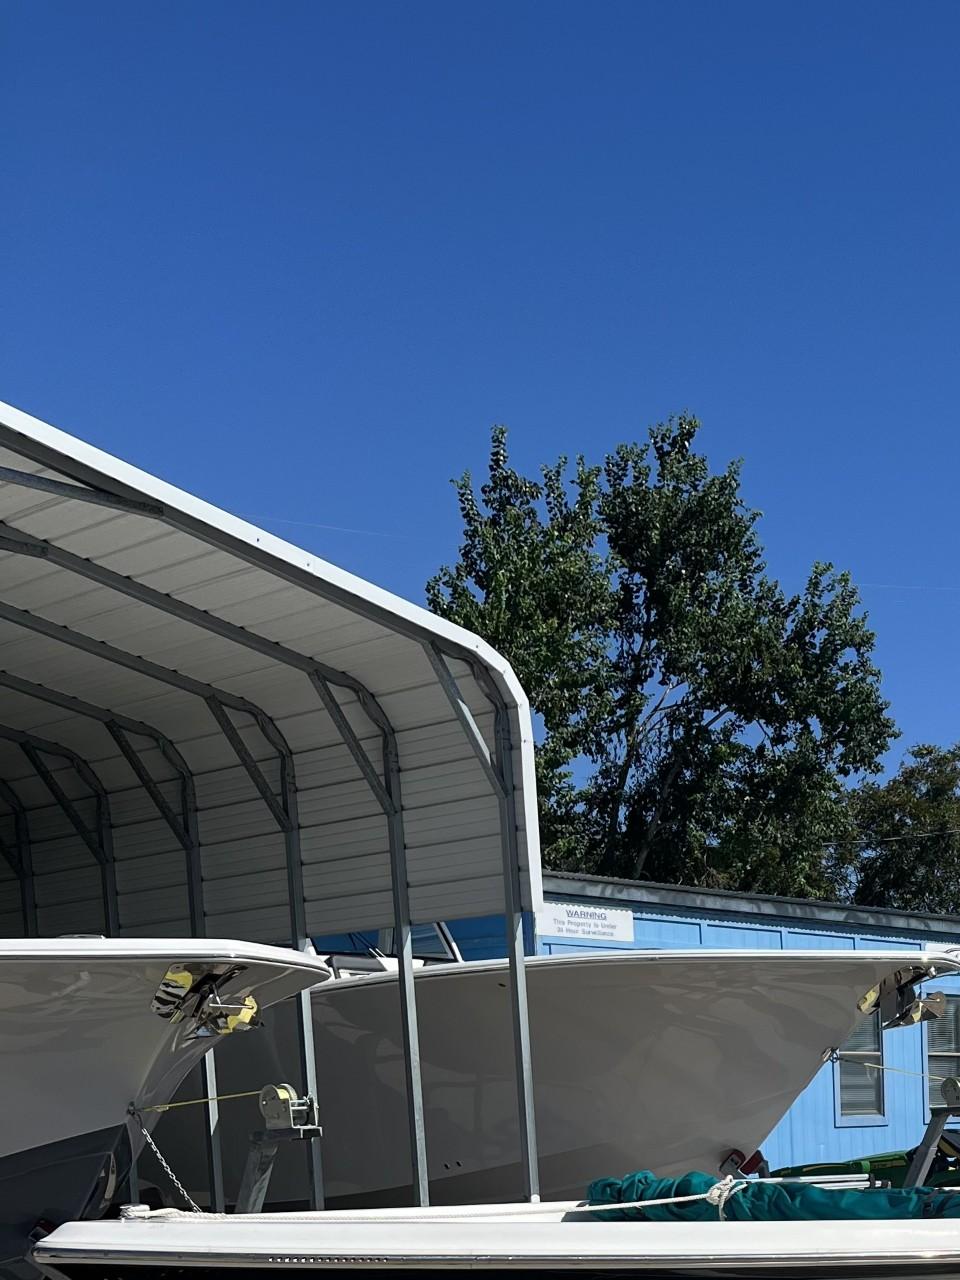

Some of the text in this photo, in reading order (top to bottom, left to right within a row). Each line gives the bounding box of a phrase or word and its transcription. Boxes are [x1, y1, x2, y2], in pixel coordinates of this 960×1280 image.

[566, 909, 607, 920] WARNING
[567, 920, 591, 928] Property
[601, 921, 617, 929] Under
